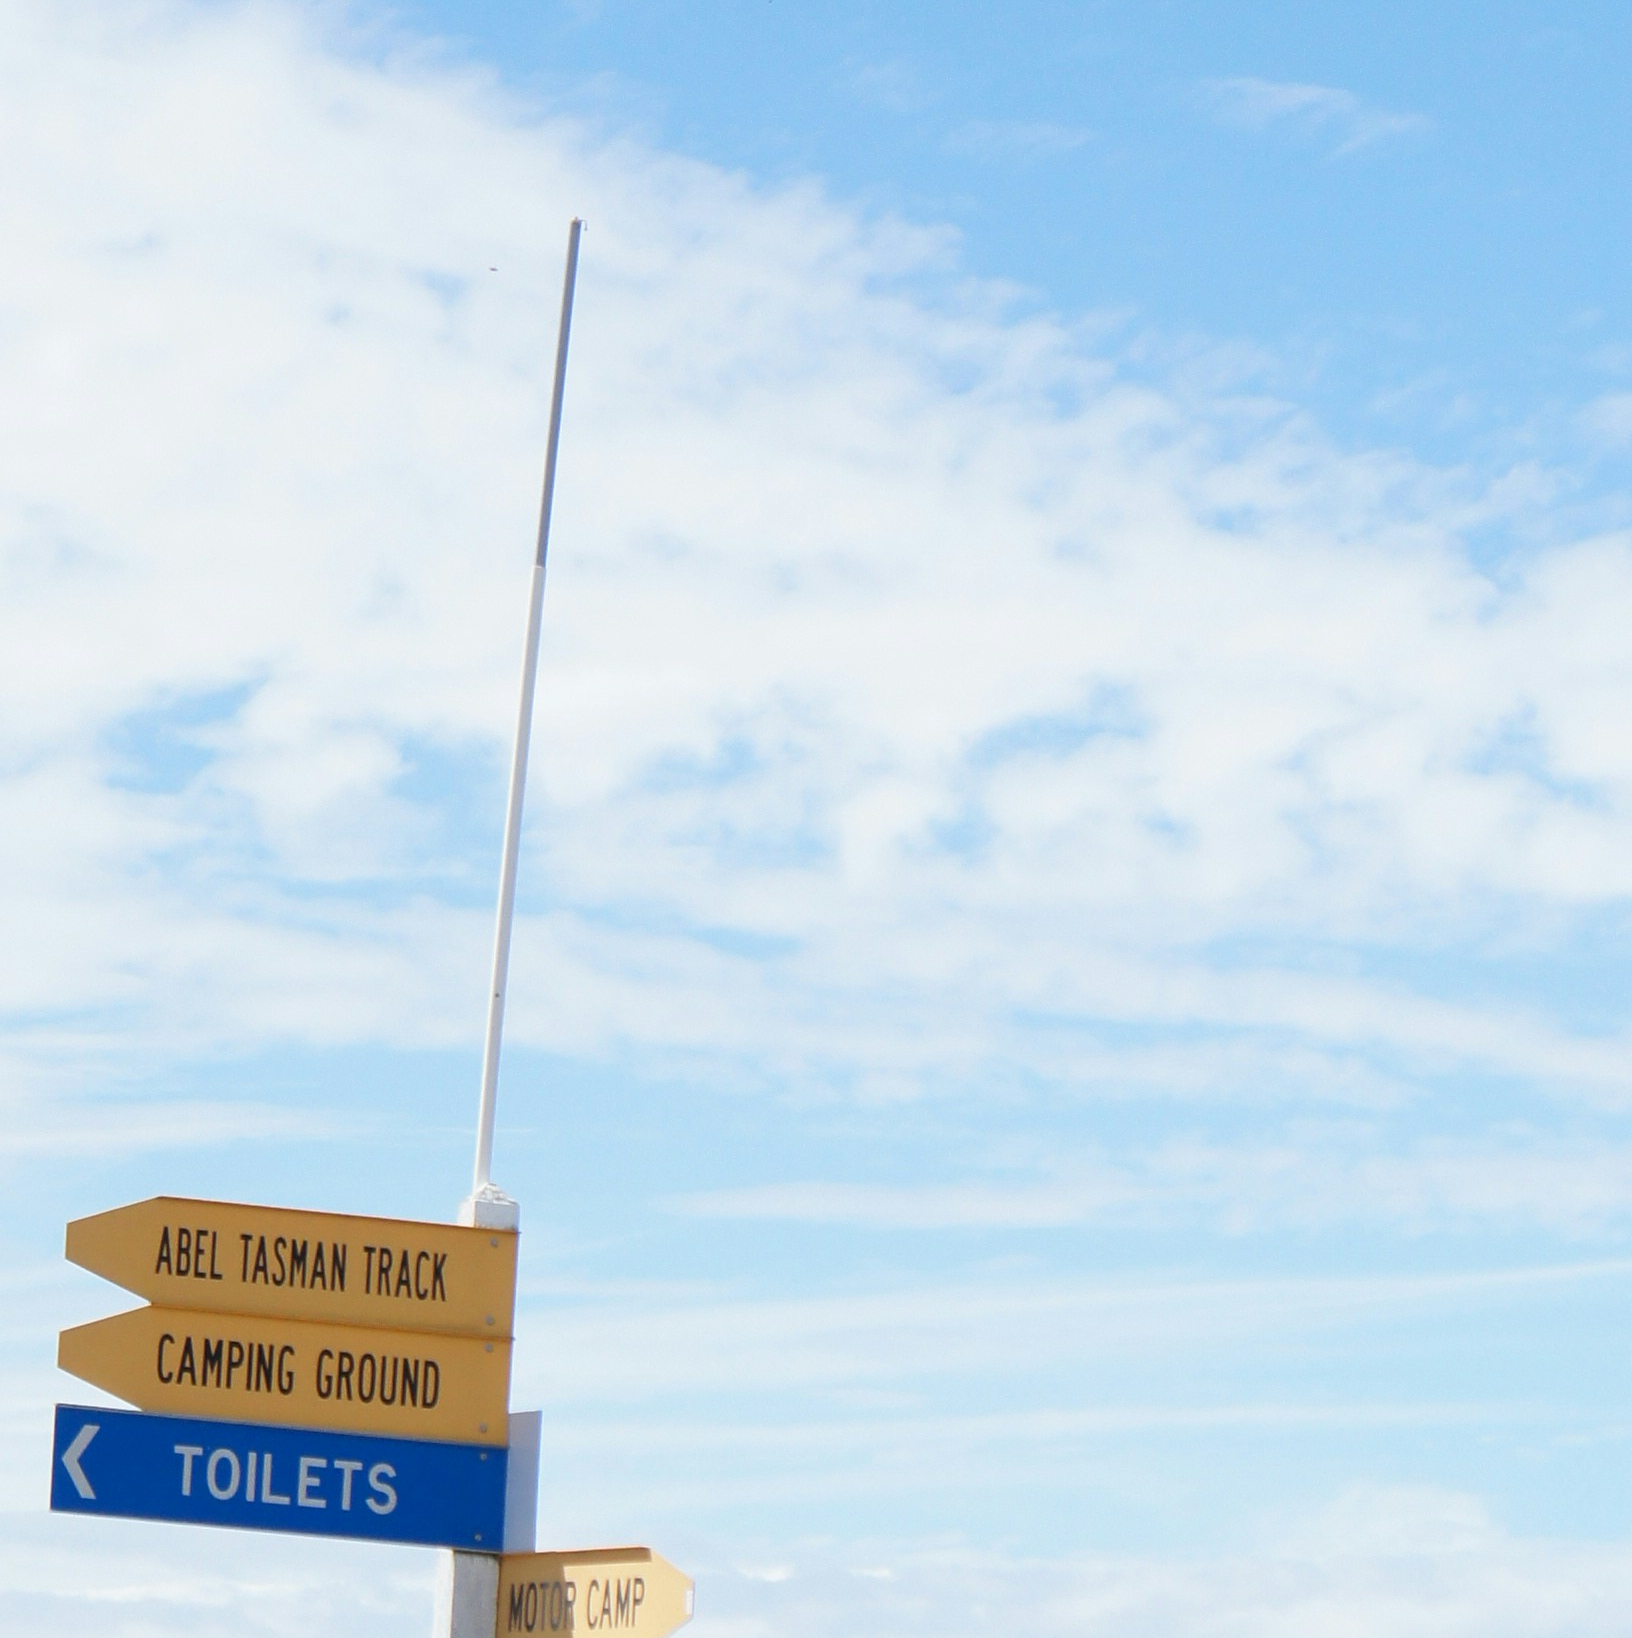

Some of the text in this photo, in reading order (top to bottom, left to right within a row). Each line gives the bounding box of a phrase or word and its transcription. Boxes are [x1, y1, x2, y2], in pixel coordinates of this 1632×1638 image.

[155, 1226, 448, 1301] ABEL TASMAN TRACK
[156, 1333, 440, 1409] CAMPING GROUND
[174, 1444, 398, 1515] TOILETS
[507, 1577, 645, 1632] MOTOR CAMP
